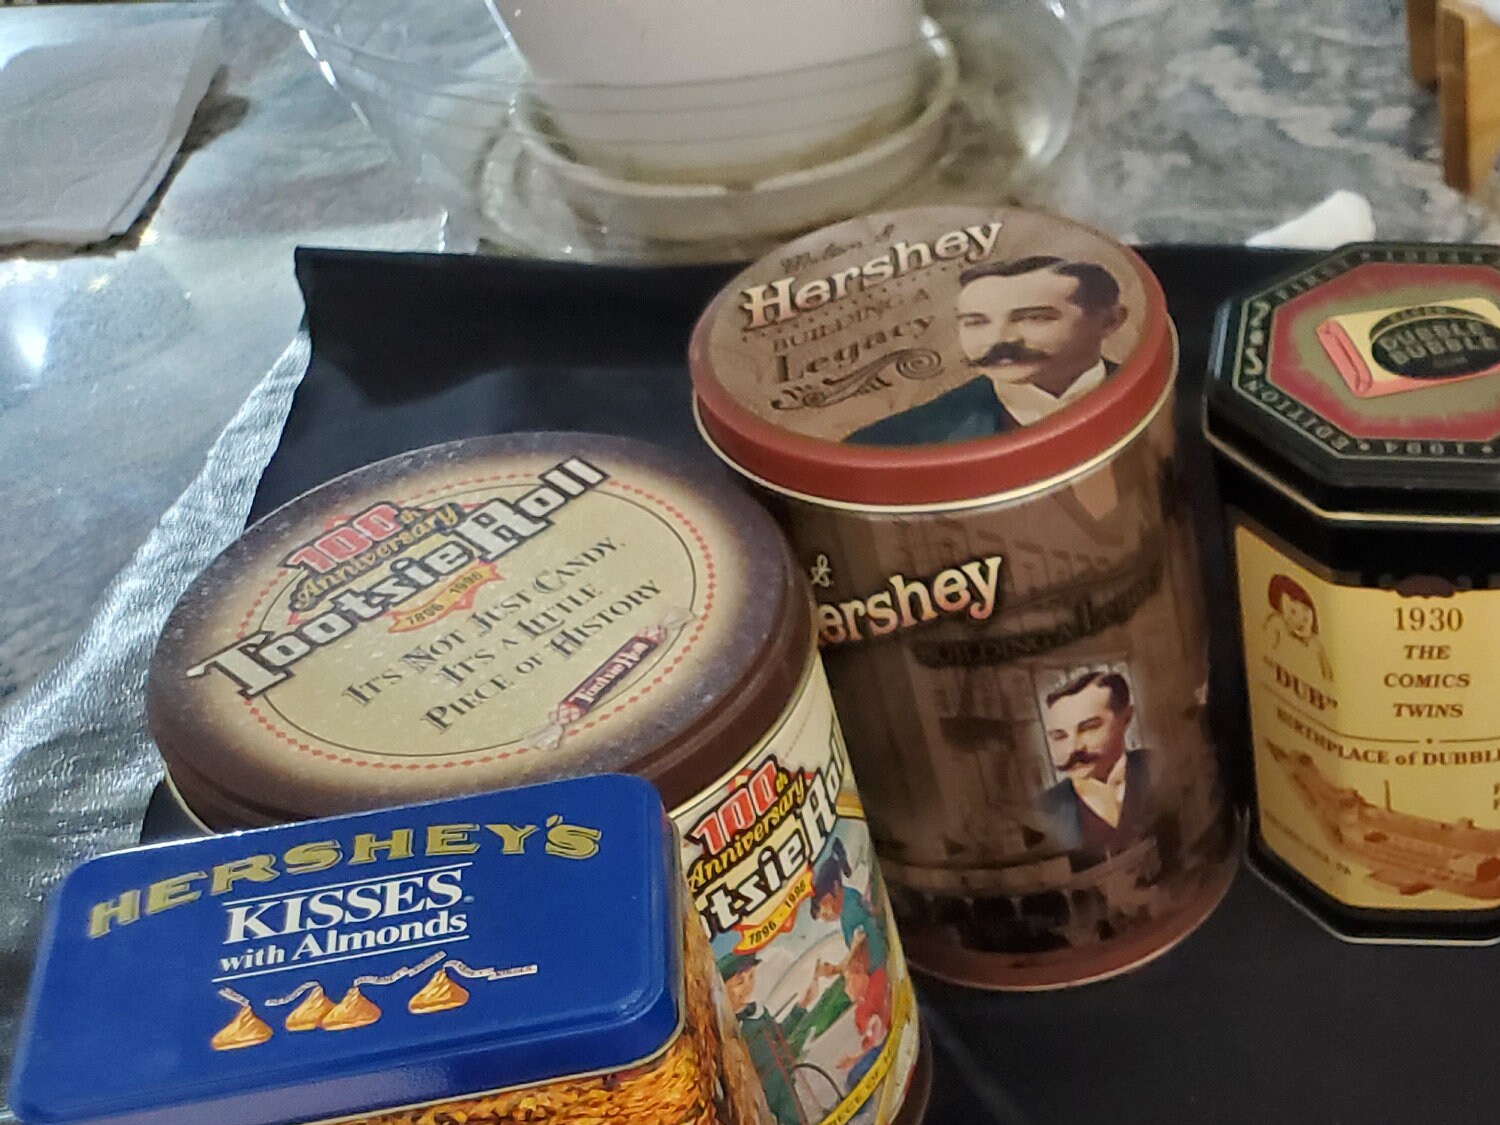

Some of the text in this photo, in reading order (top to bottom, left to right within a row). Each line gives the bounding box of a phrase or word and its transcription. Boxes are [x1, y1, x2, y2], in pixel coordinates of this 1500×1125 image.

[738, 221, 1003, 334] Hershey
[186, 455, 610, 700] Tootsie Roll
[294, 502, 466, 612] Anniversary
[817, 555, 1003, 646] ershey
[1393, 607, 1464, 632] 1930
[345, 650, 403, 707] IT'S
[400, 626, 468, 673] NOT
[467, 589, 533, 638] JUST
[421, 579, 663, 735] PIECE OF HISTORY
[438, 648, 496, 688] IT'S
[1383, 672, 1471, 688] COMICS
[1404, 644, 1451, 660] THE
[1276, 706, 1391, 766] BIRTHPLACE
[1395, 753, 1417, 766] of
[1392, 702, 1464, 718] TWINS
[688, 772, 806, 893] Anniversary
[86, 812, 602, 940] HERSHEY'S
[221, 866, 466, 947] KISSES
[219, 910, 469, 973] with Almonds
